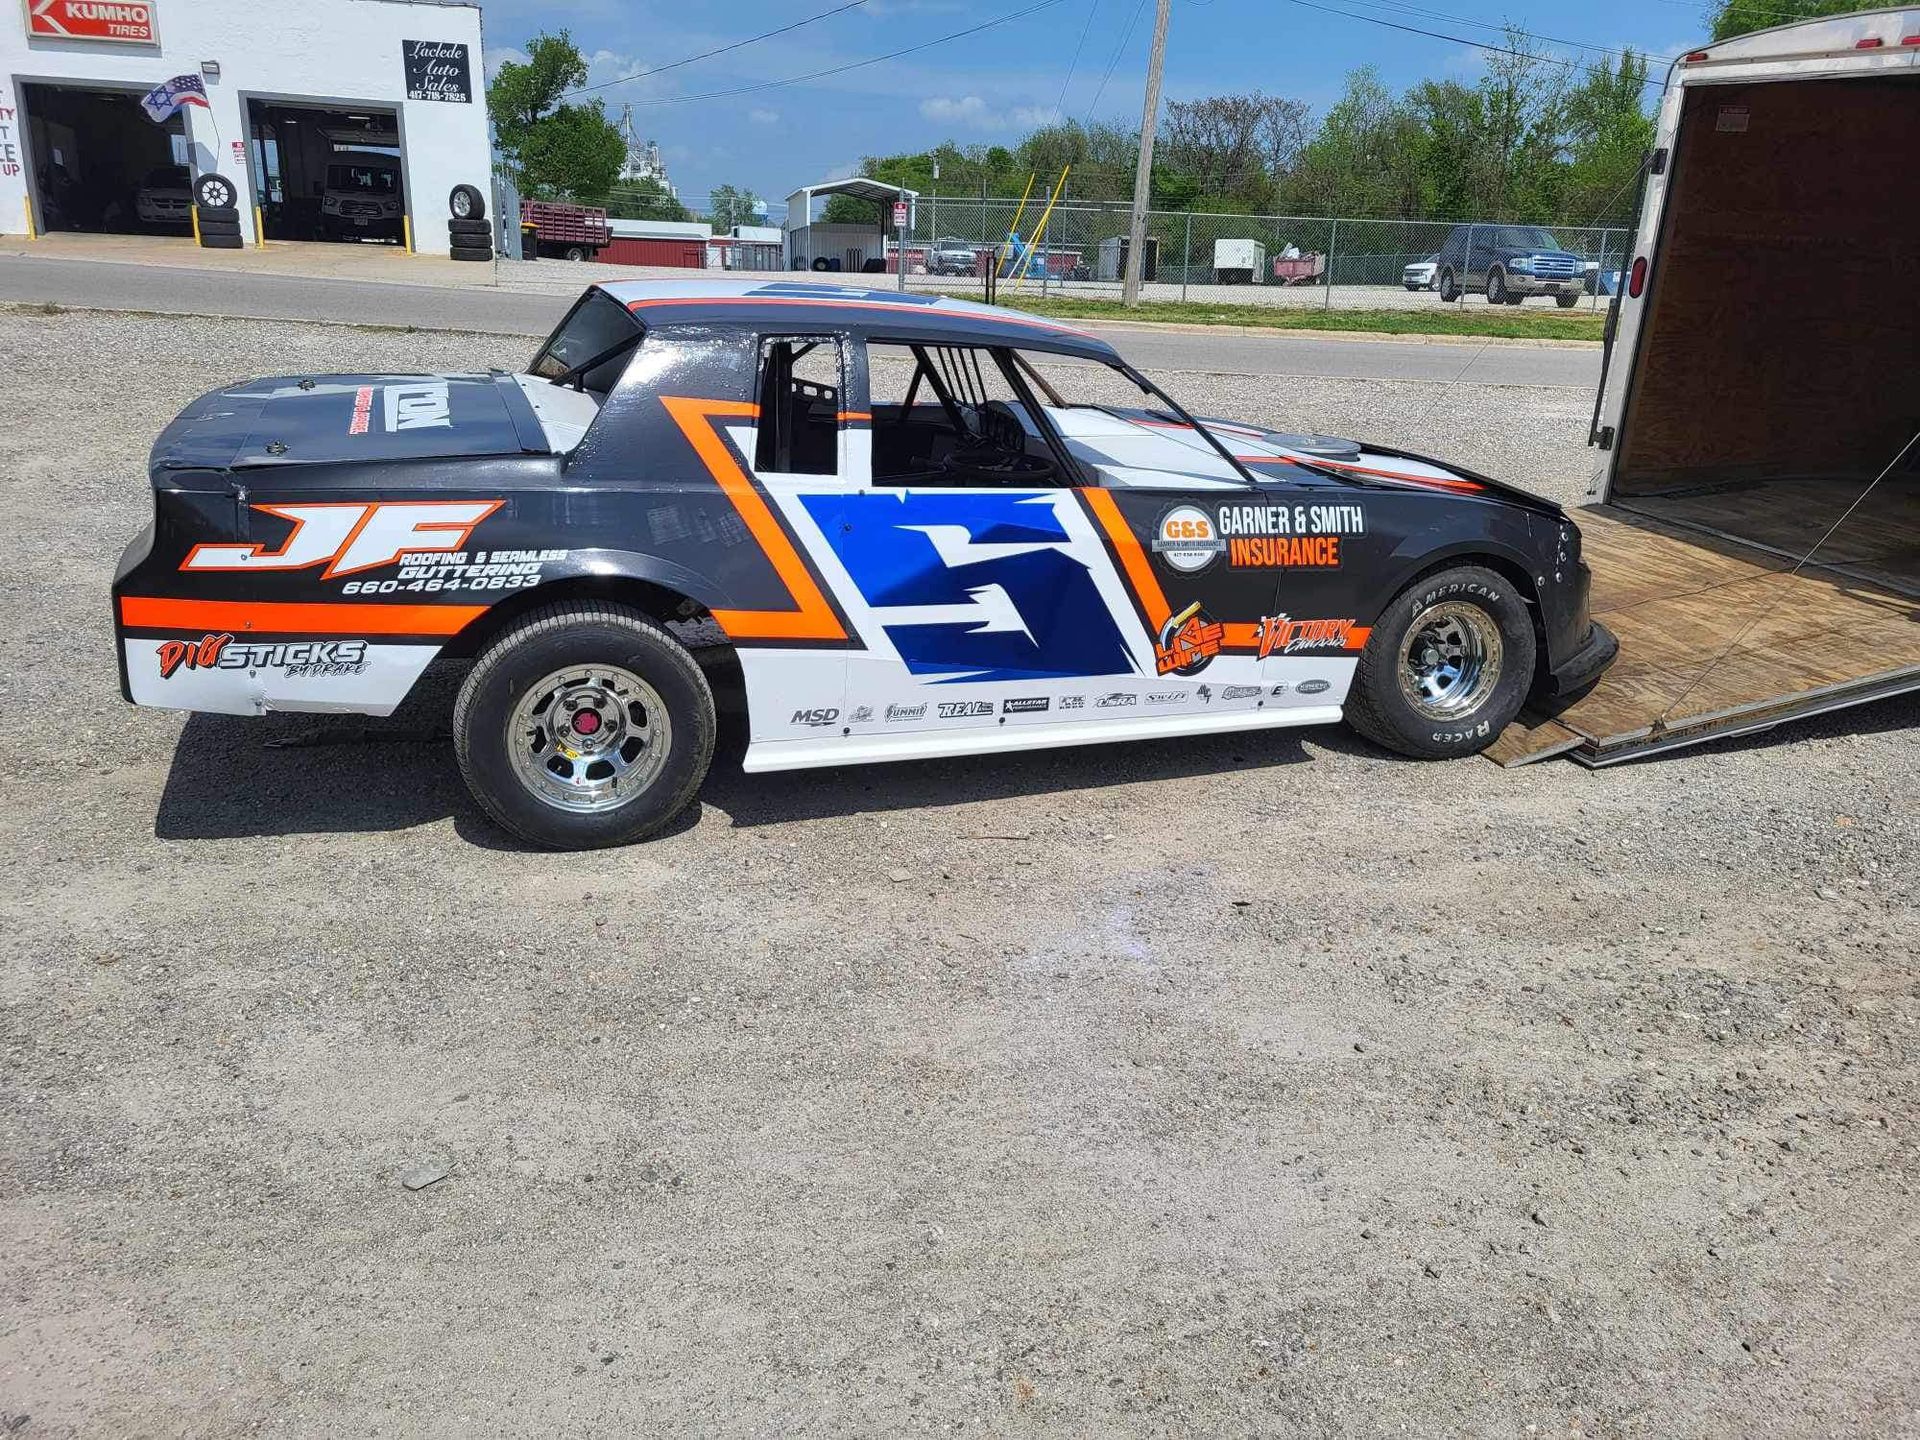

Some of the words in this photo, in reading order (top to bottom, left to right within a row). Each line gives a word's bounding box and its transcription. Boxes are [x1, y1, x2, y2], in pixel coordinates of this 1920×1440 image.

[65, 2, 148, 23] KUMHO
[108, 24, 148, 37] TIRES
[408, 41, 463, 60] Laclede
[413, 58, 460, 77] Auto
[415, 75, 461, 92] Sales
[3, 163, 21, 177] UP
[1166, 521, 1209, 539] G&S
[1219, 506, 1290, 535] GARNER
[1294, 506, 1307, 534] &
[1310, 506, 1364, 533] SMITH
[177, 499, 507, 580] JF
[399, 551, 468, 566] ROOFING
[474, 551, 486, 564] &
[489, 549, 569, 563] SEAMLESS
[1230, 536, 1339, 567] INSURANCE
[397, 562, 543, 579] GUTTERING
[341, 574, 542, 595] 660-464-0833
[1411, 582, 1500, 619] AMERICAN
[1259, 618, 1356, 657] VICTORY
[790, 708, 839, 724] MSD
[884, 703, 927, 721] SUMMIT
[938, 701, 984, 717] REAL
[1431, 720, 1491, 744] RACER
